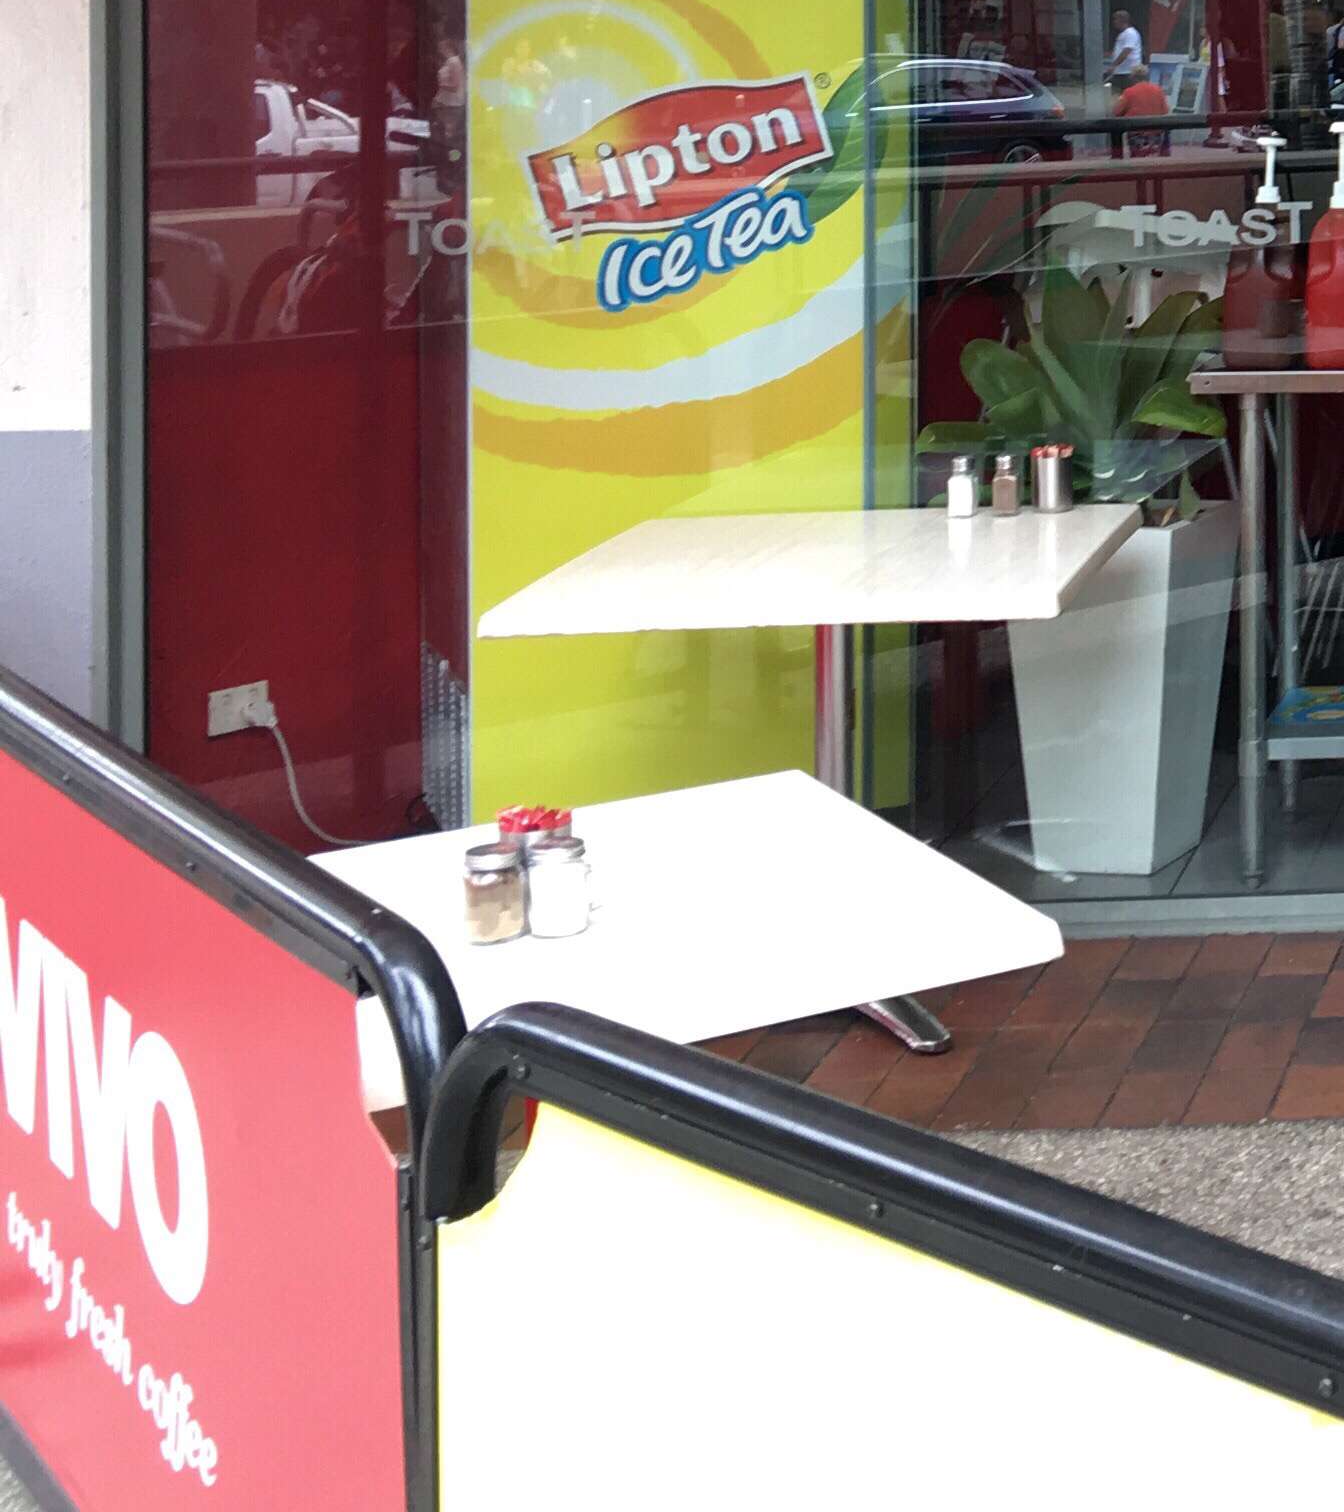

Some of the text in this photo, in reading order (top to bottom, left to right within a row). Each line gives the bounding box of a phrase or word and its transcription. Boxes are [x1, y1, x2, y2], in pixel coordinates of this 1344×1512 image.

[548, 105, 804, 213] Lipton
[394, 211, 596, 256] TOAST
[603, 194, 805, 307] Ice Tea
[1120, 201, 1314, 247] TOAST
[7, 1191, 218, 1487] truly fresh coffee
